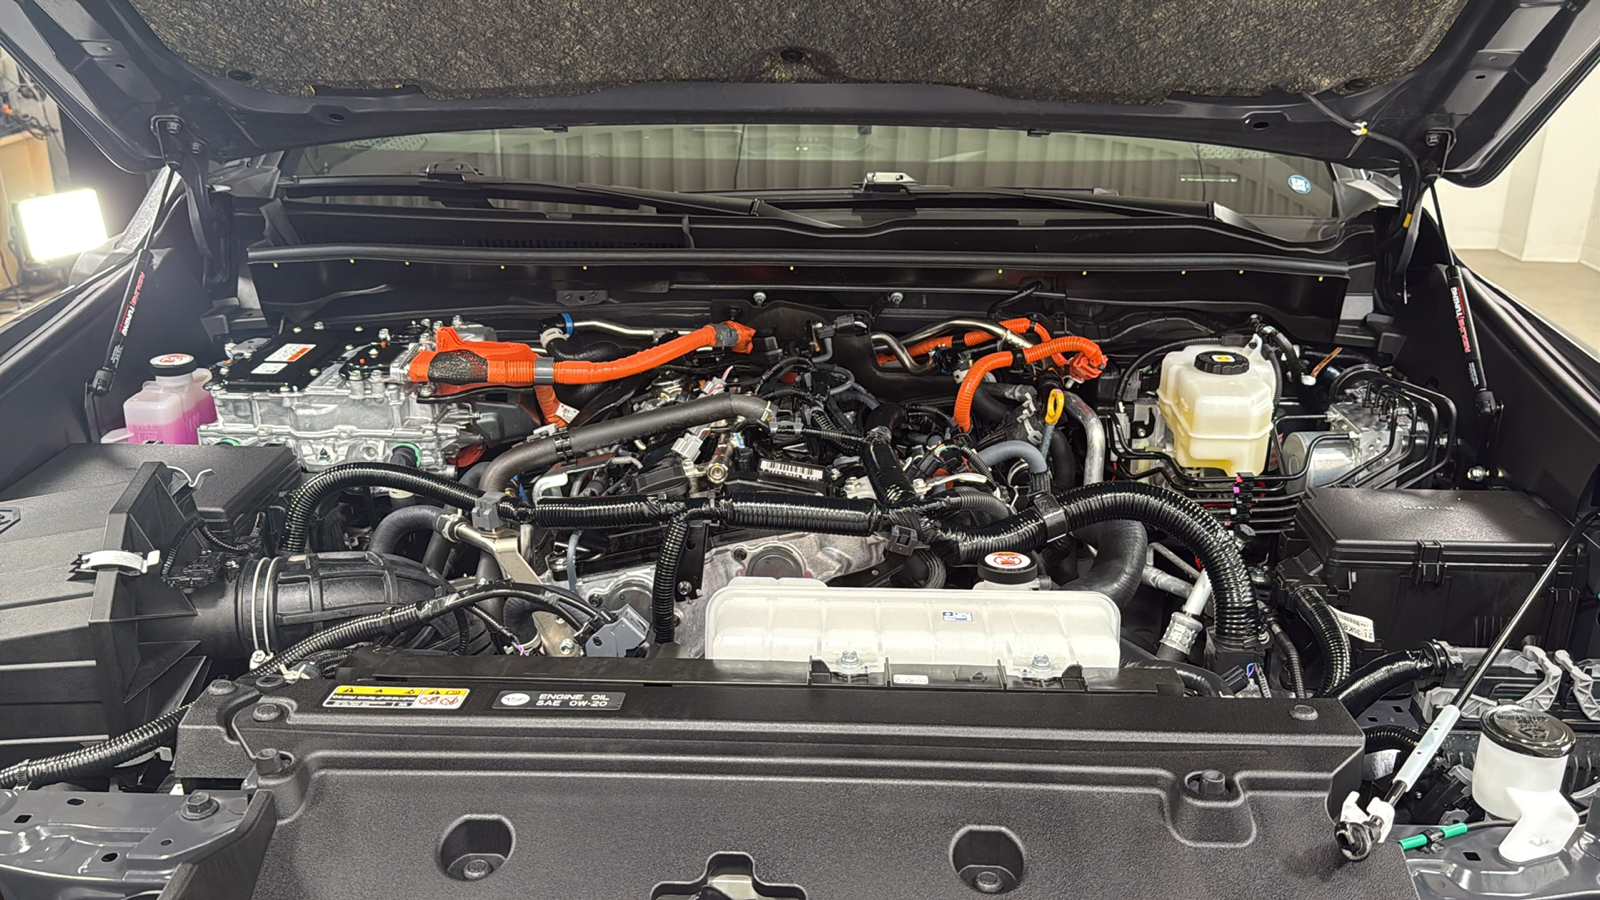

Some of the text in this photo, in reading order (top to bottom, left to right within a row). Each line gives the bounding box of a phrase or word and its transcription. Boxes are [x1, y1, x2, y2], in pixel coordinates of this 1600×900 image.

[1451, 287, 1463, 317] TUNING
[121, 305, 135, 336] TUNING
[1457, 318, 1471, 353] REDLINE
[538, 693, 585, 701] ENGINE
